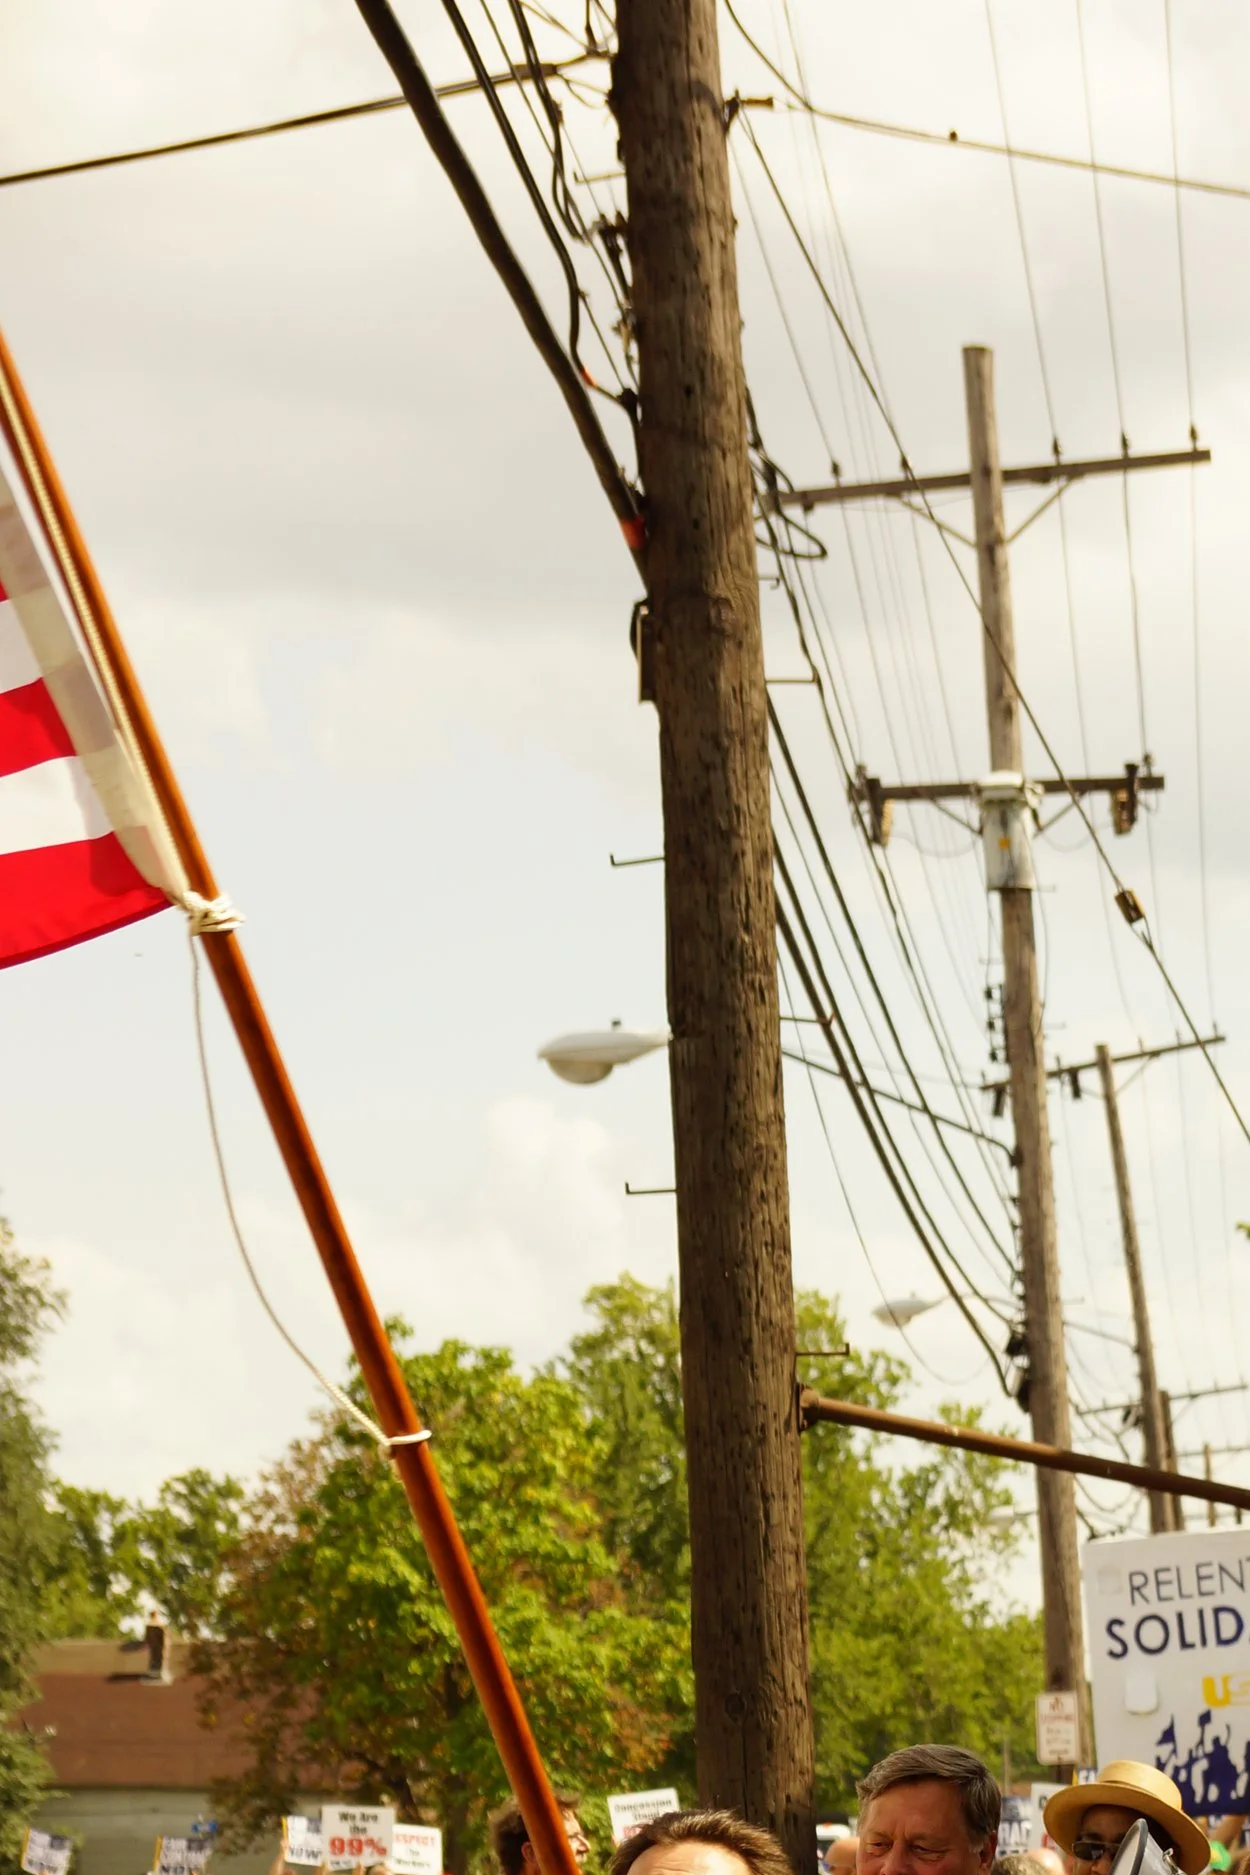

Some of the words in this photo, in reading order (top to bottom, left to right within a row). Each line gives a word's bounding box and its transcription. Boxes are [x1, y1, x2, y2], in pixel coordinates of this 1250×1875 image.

[337, 1811, 357, 1822] We
[359, 1810, 379, 1822] Are
[349, 1824, 368, 1835] the
[329, 1836, 388, 1857] 99%
[395, 1833, 436, 1848] ESPECT
